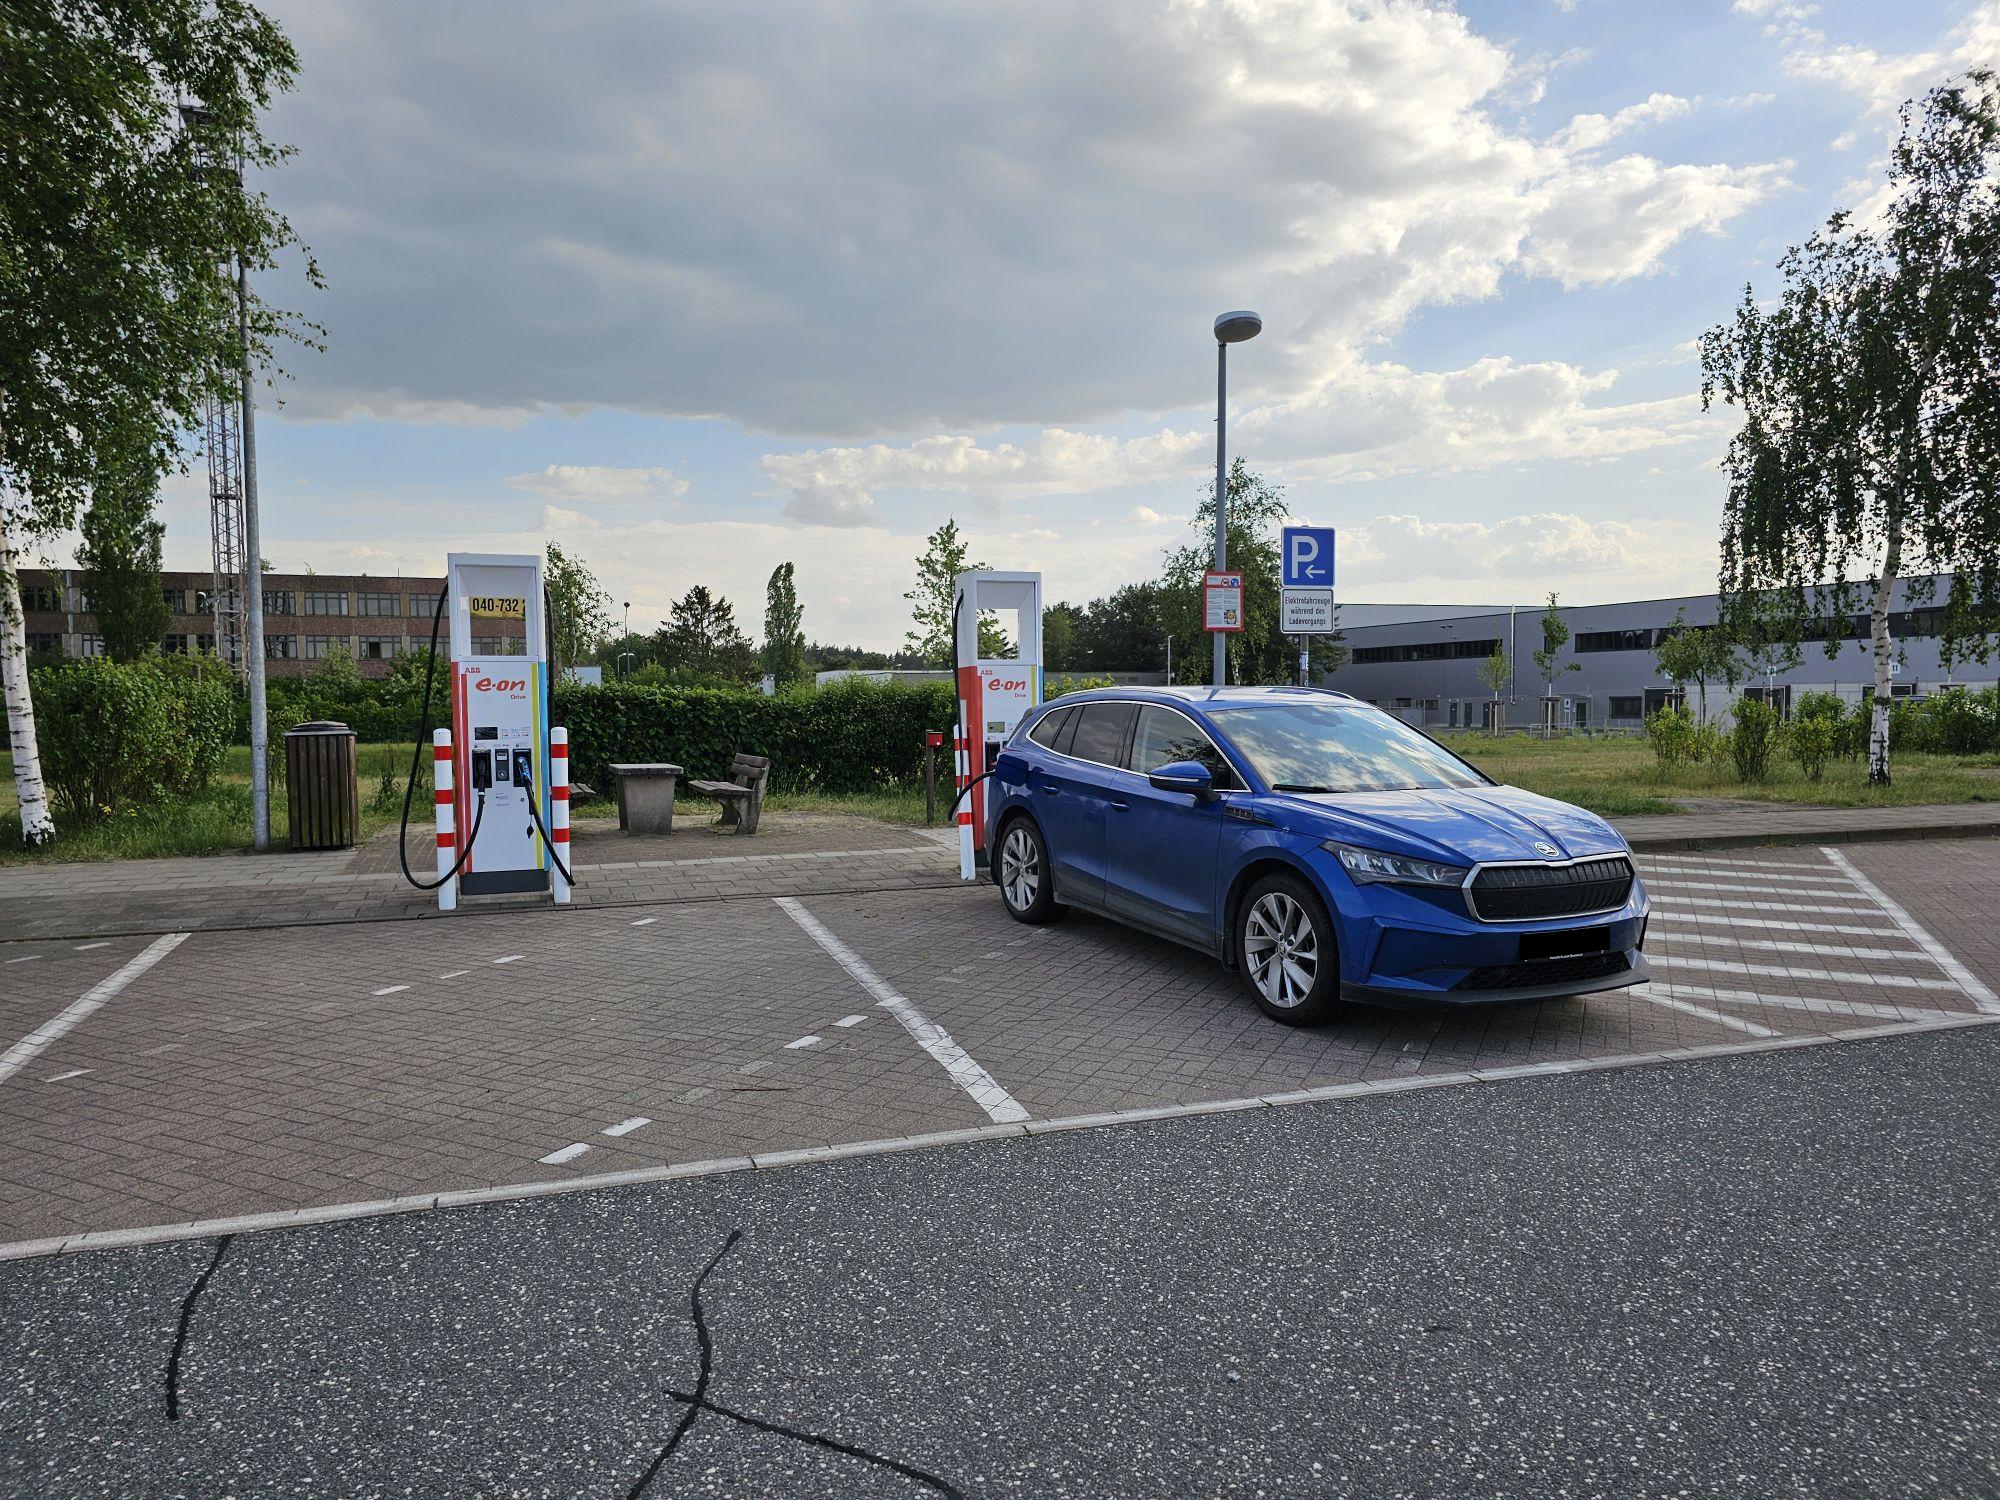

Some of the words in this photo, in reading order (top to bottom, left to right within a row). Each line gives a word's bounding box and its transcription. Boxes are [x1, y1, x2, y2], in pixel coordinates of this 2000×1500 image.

[1291, 535, 1319, 579] P
[472, 598, 519, 612] 040-732
[1285, 597, 1330, 606] Elektrofahrzeuge
[1291, 607, 1313, 615] während
[1316, 607, 1325, 615] des
[1289, 617, 1326, 626] Ladevorgangs
